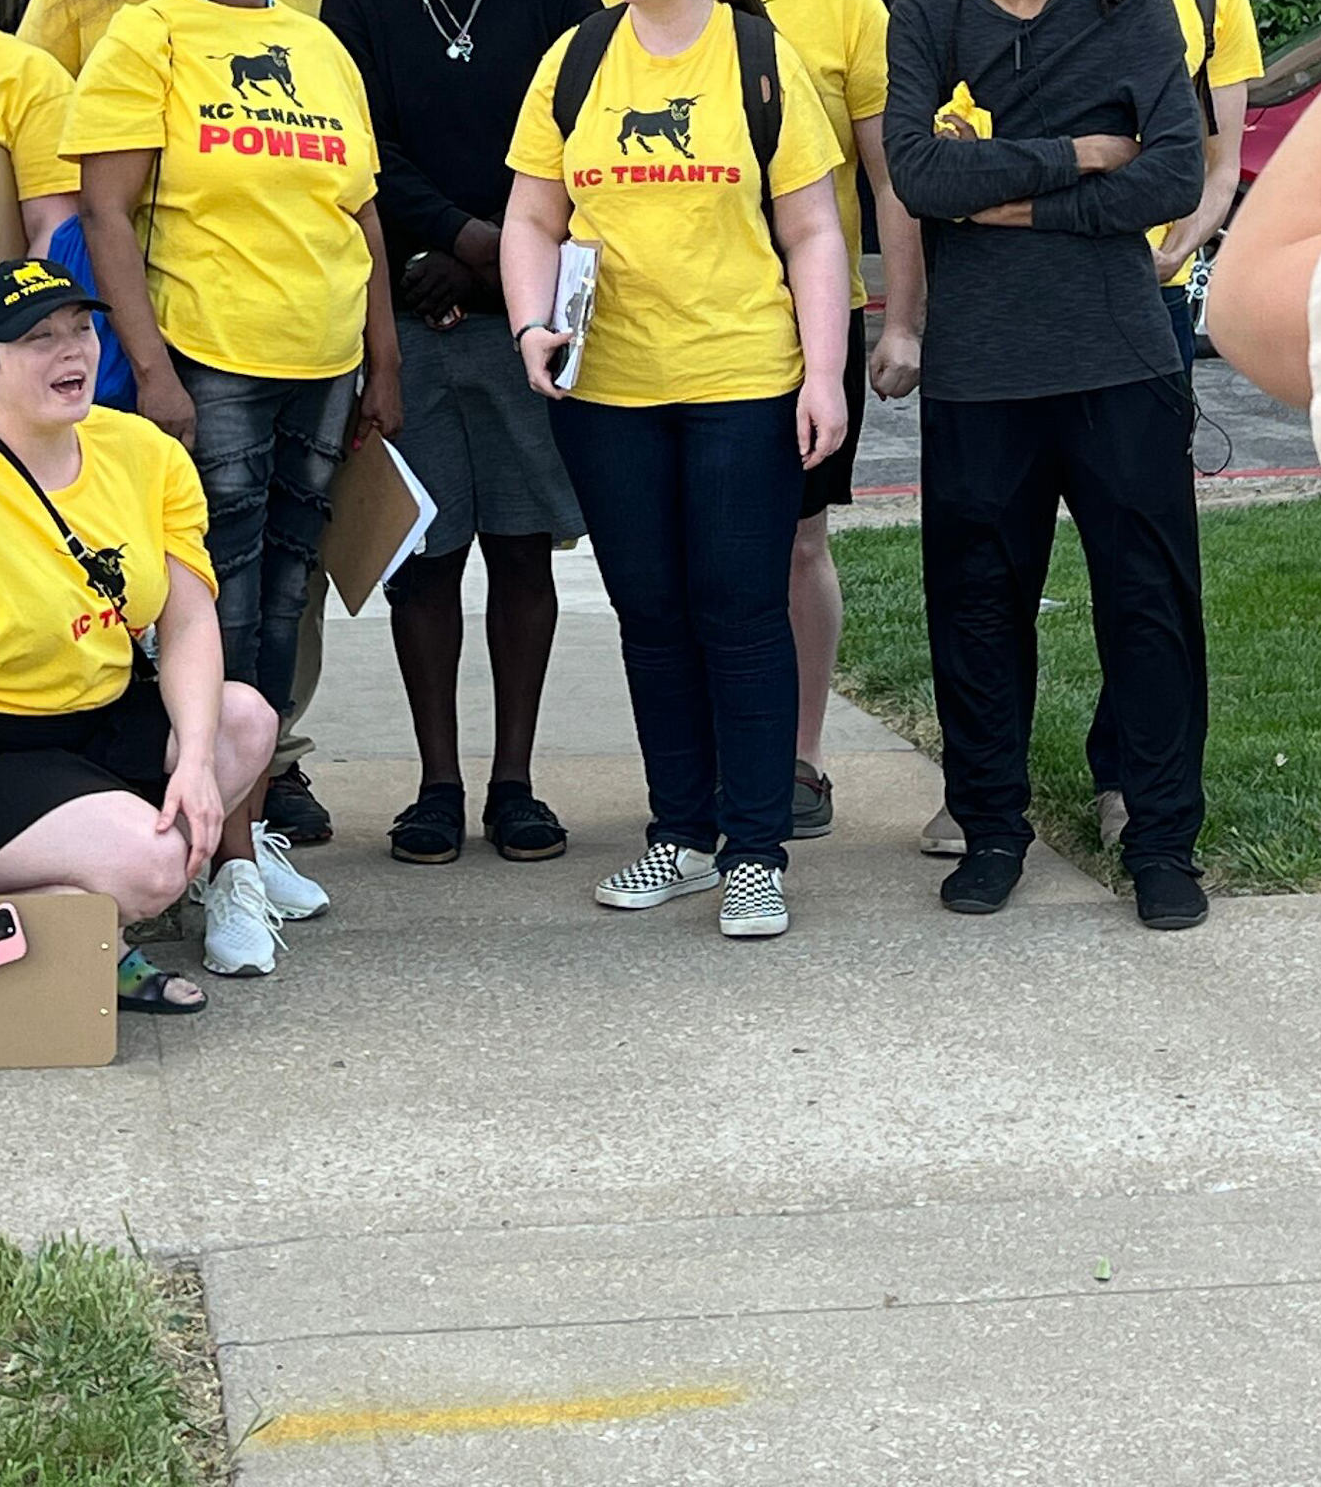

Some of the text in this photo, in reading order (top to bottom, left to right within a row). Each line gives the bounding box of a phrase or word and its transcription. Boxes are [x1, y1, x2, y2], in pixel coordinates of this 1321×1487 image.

[199, 103, 344, 131] KC TENANTS
[199, 124, 347, 166] POWER
[573, 165, 741, 188] KC TENANTS
